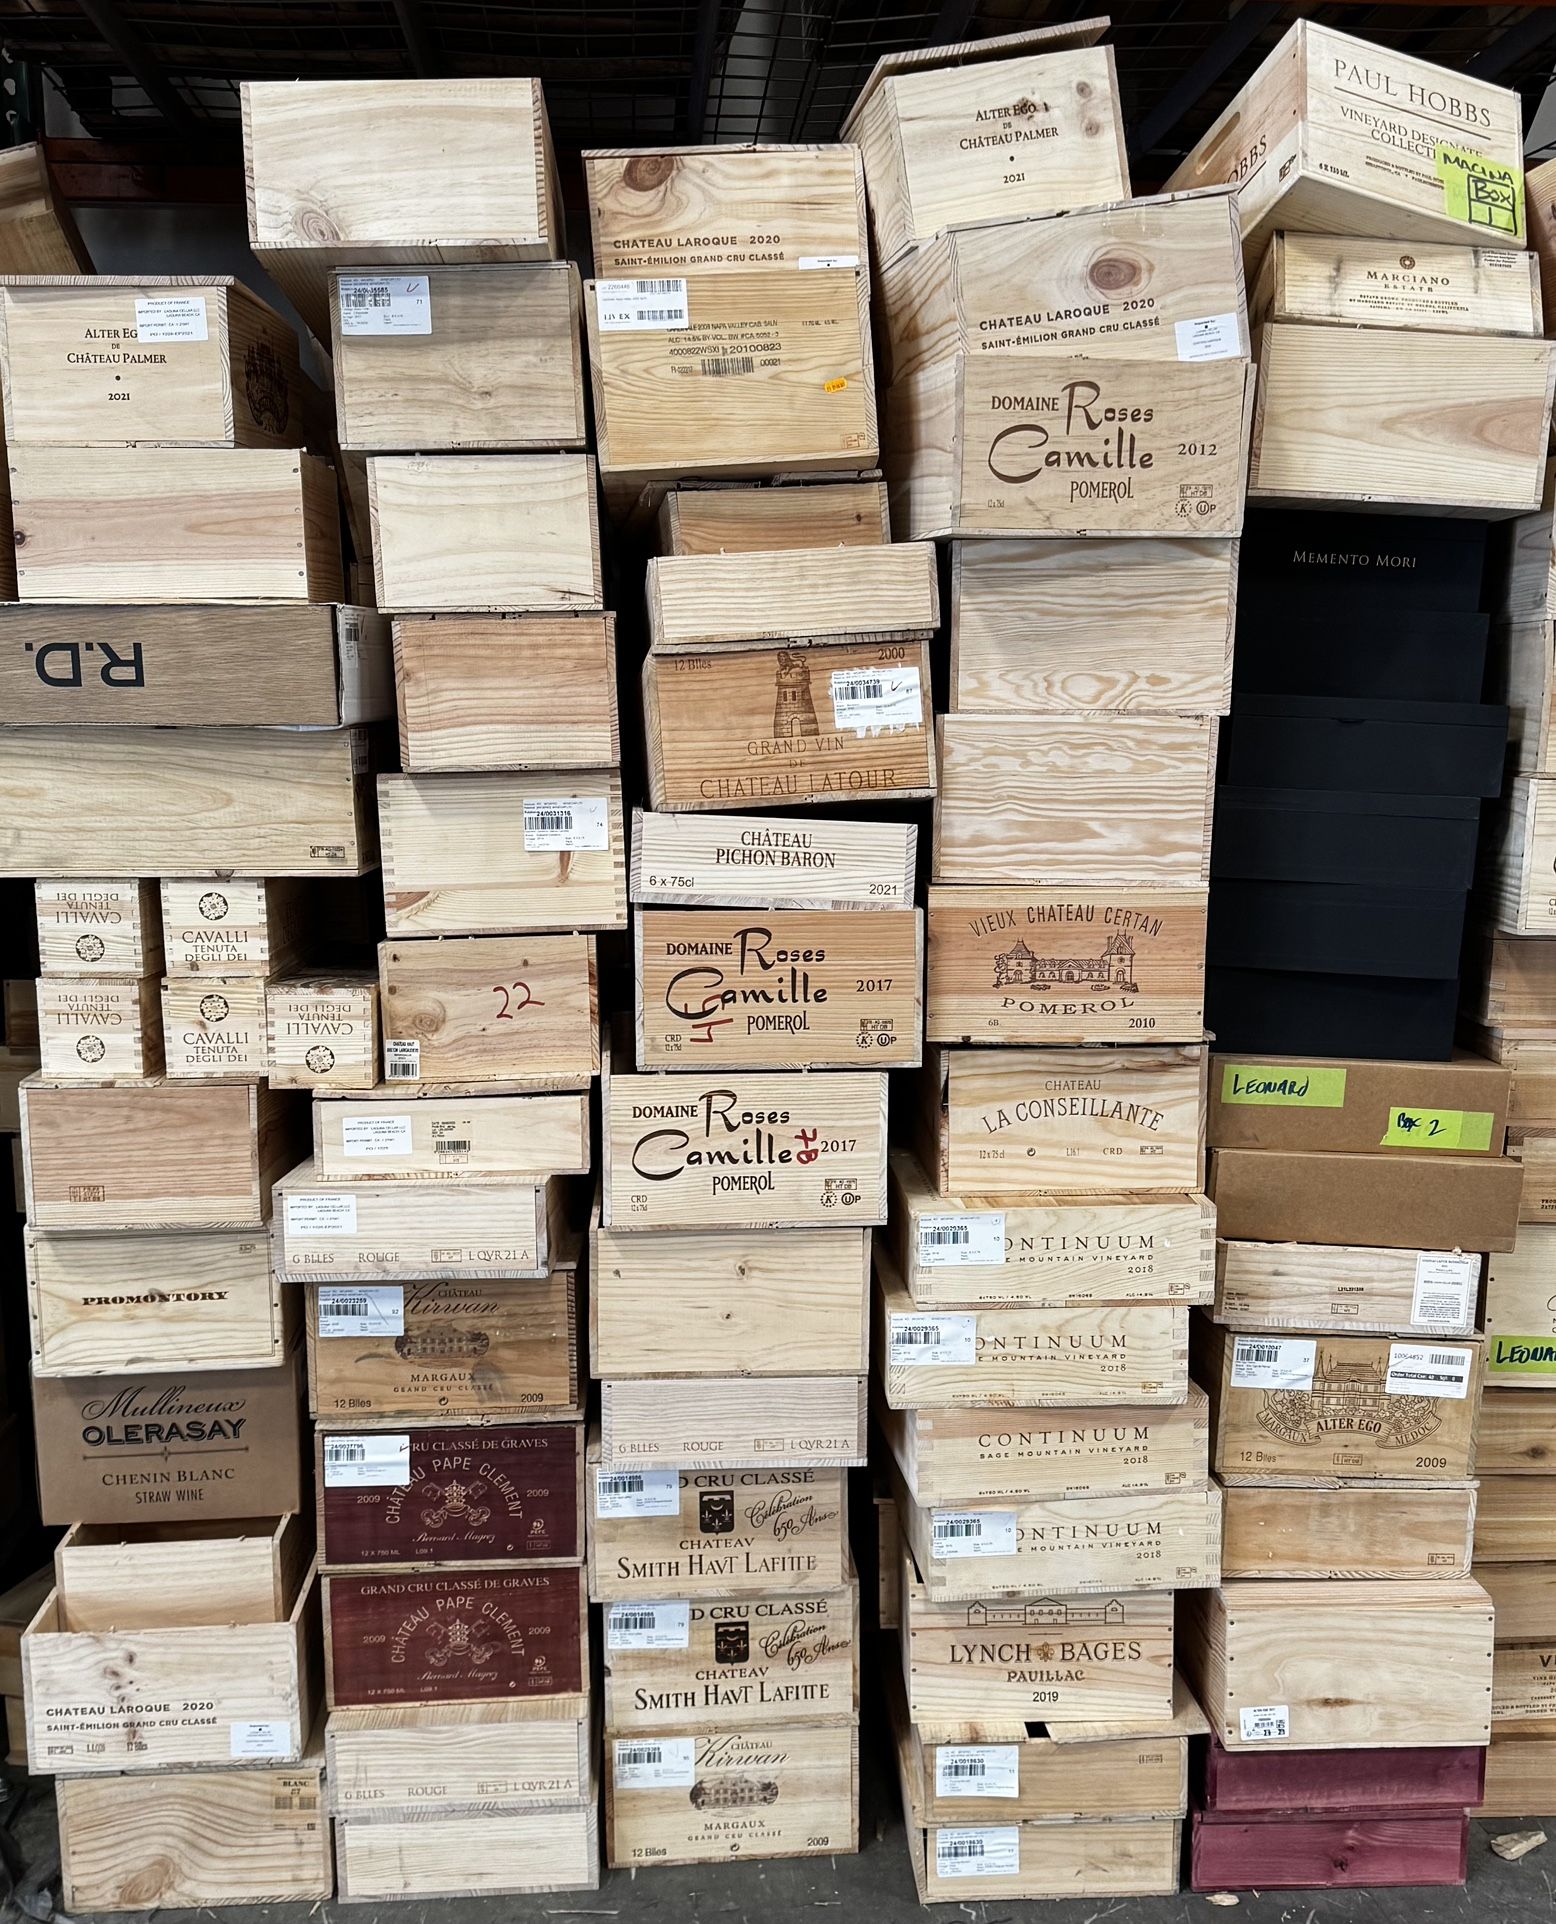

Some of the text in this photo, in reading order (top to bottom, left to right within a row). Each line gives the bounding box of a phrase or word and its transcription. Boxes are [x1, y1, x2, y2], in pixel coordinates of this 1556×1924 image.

[1333, 58, 1492, 127] PAUL HOBBS
[976, 106, 1011, 122] ALTER
[1341, 106, 1408, 136] VINEYARD
[960, 126, 1059, 150] CHÂTEAU PALMER
[1371, 130, 1436, 159] COLLECTI
[1223, 134, 1268, 185] OBBS
[1003, 172, 1026, 184] 2021
[614, 235, 781, 249] CHATEAU LAROQUE 2020
[614, 252, 784, 266] SAINT-ÉMILION GRAND CRU CLASSÉ
[1367, 271, 1450, 286] MARCIANO
[1384, 284, 1434, 293] ESTATE
[980, 298, 1155, 331] CHATEAU LAROQUE 2020
[84, 328, 138, 339] ALTER EG
[982, 316, 1160, 350] SAINT-ÉMILION GRAND CRU CLASSÉ
[730, 343, 782, 354] 20100823
[67, 352, 167, 364] CHÂTEAU PALMER
[108, 392, 130, 401] 2021
[992, 380, 1154, 435] DOMAINE Roses
[989, 424, 1154, 484] Camille
[1178, 443, 1217, 455] 2012
[1070, 477, 1133, 504] POMEROL
[1293, 551, 1416, 568] MEMENTO MORI
[878, 648, 905, 660] 2000
[24, 642, 145, 688] R.D.
[674, 660, 686, 671] 12
[748, 736, 844, 756] GRAND VIN
[700, 769, 896, 799] CHATEAU LATOUR
[740, 829, 812, 848] CHÂTEAU
[716, 848, 836, 868] PICHON BARON
[650, 876, 656, 886] 6
[670, 876, 694, 888] 75cl
[869, 884, 897, 895] 2021
[56, 893, 119, 901] DEGLI DEI
[67, 902, 111, 910] TENUTA
[56, 911, 122, 924] CAVALLI
[969, 904, 1163, 938] VIEUX CHATEAU CERTAN
[182, 931, 248, 943] CAVALLI
[192, 945, 237, 953] TENUTA
[666, 927, 825, 975] DOMAINE Roses
[185, 953, 247, 961] DEGLI DEI
[856, 979, 893, 992] 2017
[492, 981, 545, 1019] 22
[666, 967, 828, 1019] Camille
[289, 1005, 351, 1013] DEGLI DEI
[1001, 997, 1135, 1015] POMEROL
[299, 1013, 343, 1021] TENUTA
[747, 1011, 810, 1034] POMEROL
[1129, 1018, 1155, 1028] 2010
[287, 1022, 353, 1035] CAVALLI
[665, 1034, 681, 1043] CRD
[1045, 1080, 1101, 1091] CHATEAU
[632, 1090, 790, 1137] DOMAINE Roses
[982, 1097, 1164, 1134] LA CONSEILLANTE
[1429, 1119, 1447, 1136] 2
[821, 1140, 856, 1152] 2017
[632, 1128, 792, 1180] Camille
[713, 1171, 775, 1195] POMEROL
[1005, 1236, 1154, 1250] ONTINUUM
[358, 1252, 399, 1262] ROUGE
[1019, 1255, 1084, 1263] MOUNTAIN
[1127, 1265, 1153, 1274] 2018
[82, 1291, 229, 1306] PROMONTORY
[438, 1287, 482, 1297] CHÂTEAU
[411, 1372, 476, 1383] MARGAUX
[81, 1385, 246, 1420] Mullineux
[521, 1394, 543, 1402] 2009
[82, 1419, 246, 1446] OLERASAY
[1261, 1412, 1433, 1446] MARGAUX ALTER EGO MEDOC
[979, 1427, 1149, 1447] CONTINUUM
[683, 1441, 724, 1451] ROUGE
[1018, 1449, 1081, 1457] MOUNTAIN
[1089, 1445, 1148, 1453] VINEYARD
[1123, 1456, 1148, 1465] 2018
[1415, 1457, 1447, 1468] 2009
[102, 1468, 235, 1485] CHENIN BLANC
[695, 1469, 815, 1488] CRU CLASSÉ
[136, 1489, 204, 1503] STRAW WINE
[617, 1556, 680, 1579] SMITH
[361, 1577, 549, 1595] GRAND CRU CLASSÉ DE GRAVES
[391, 1597, 524, 1663] CHÂTEAU PAPE CLEMENT
[950, 1641, 1141, 1664] LYNCH BAGES
[1008, 1670, 1085, 1682] PAUILLAC
[1032, 1691, 1059, 1702] 2019
[46, 1702, 214, 1716] CHATEAU LAROQUE 2020
[704, 1820, 766, 1831] MARGAUX
